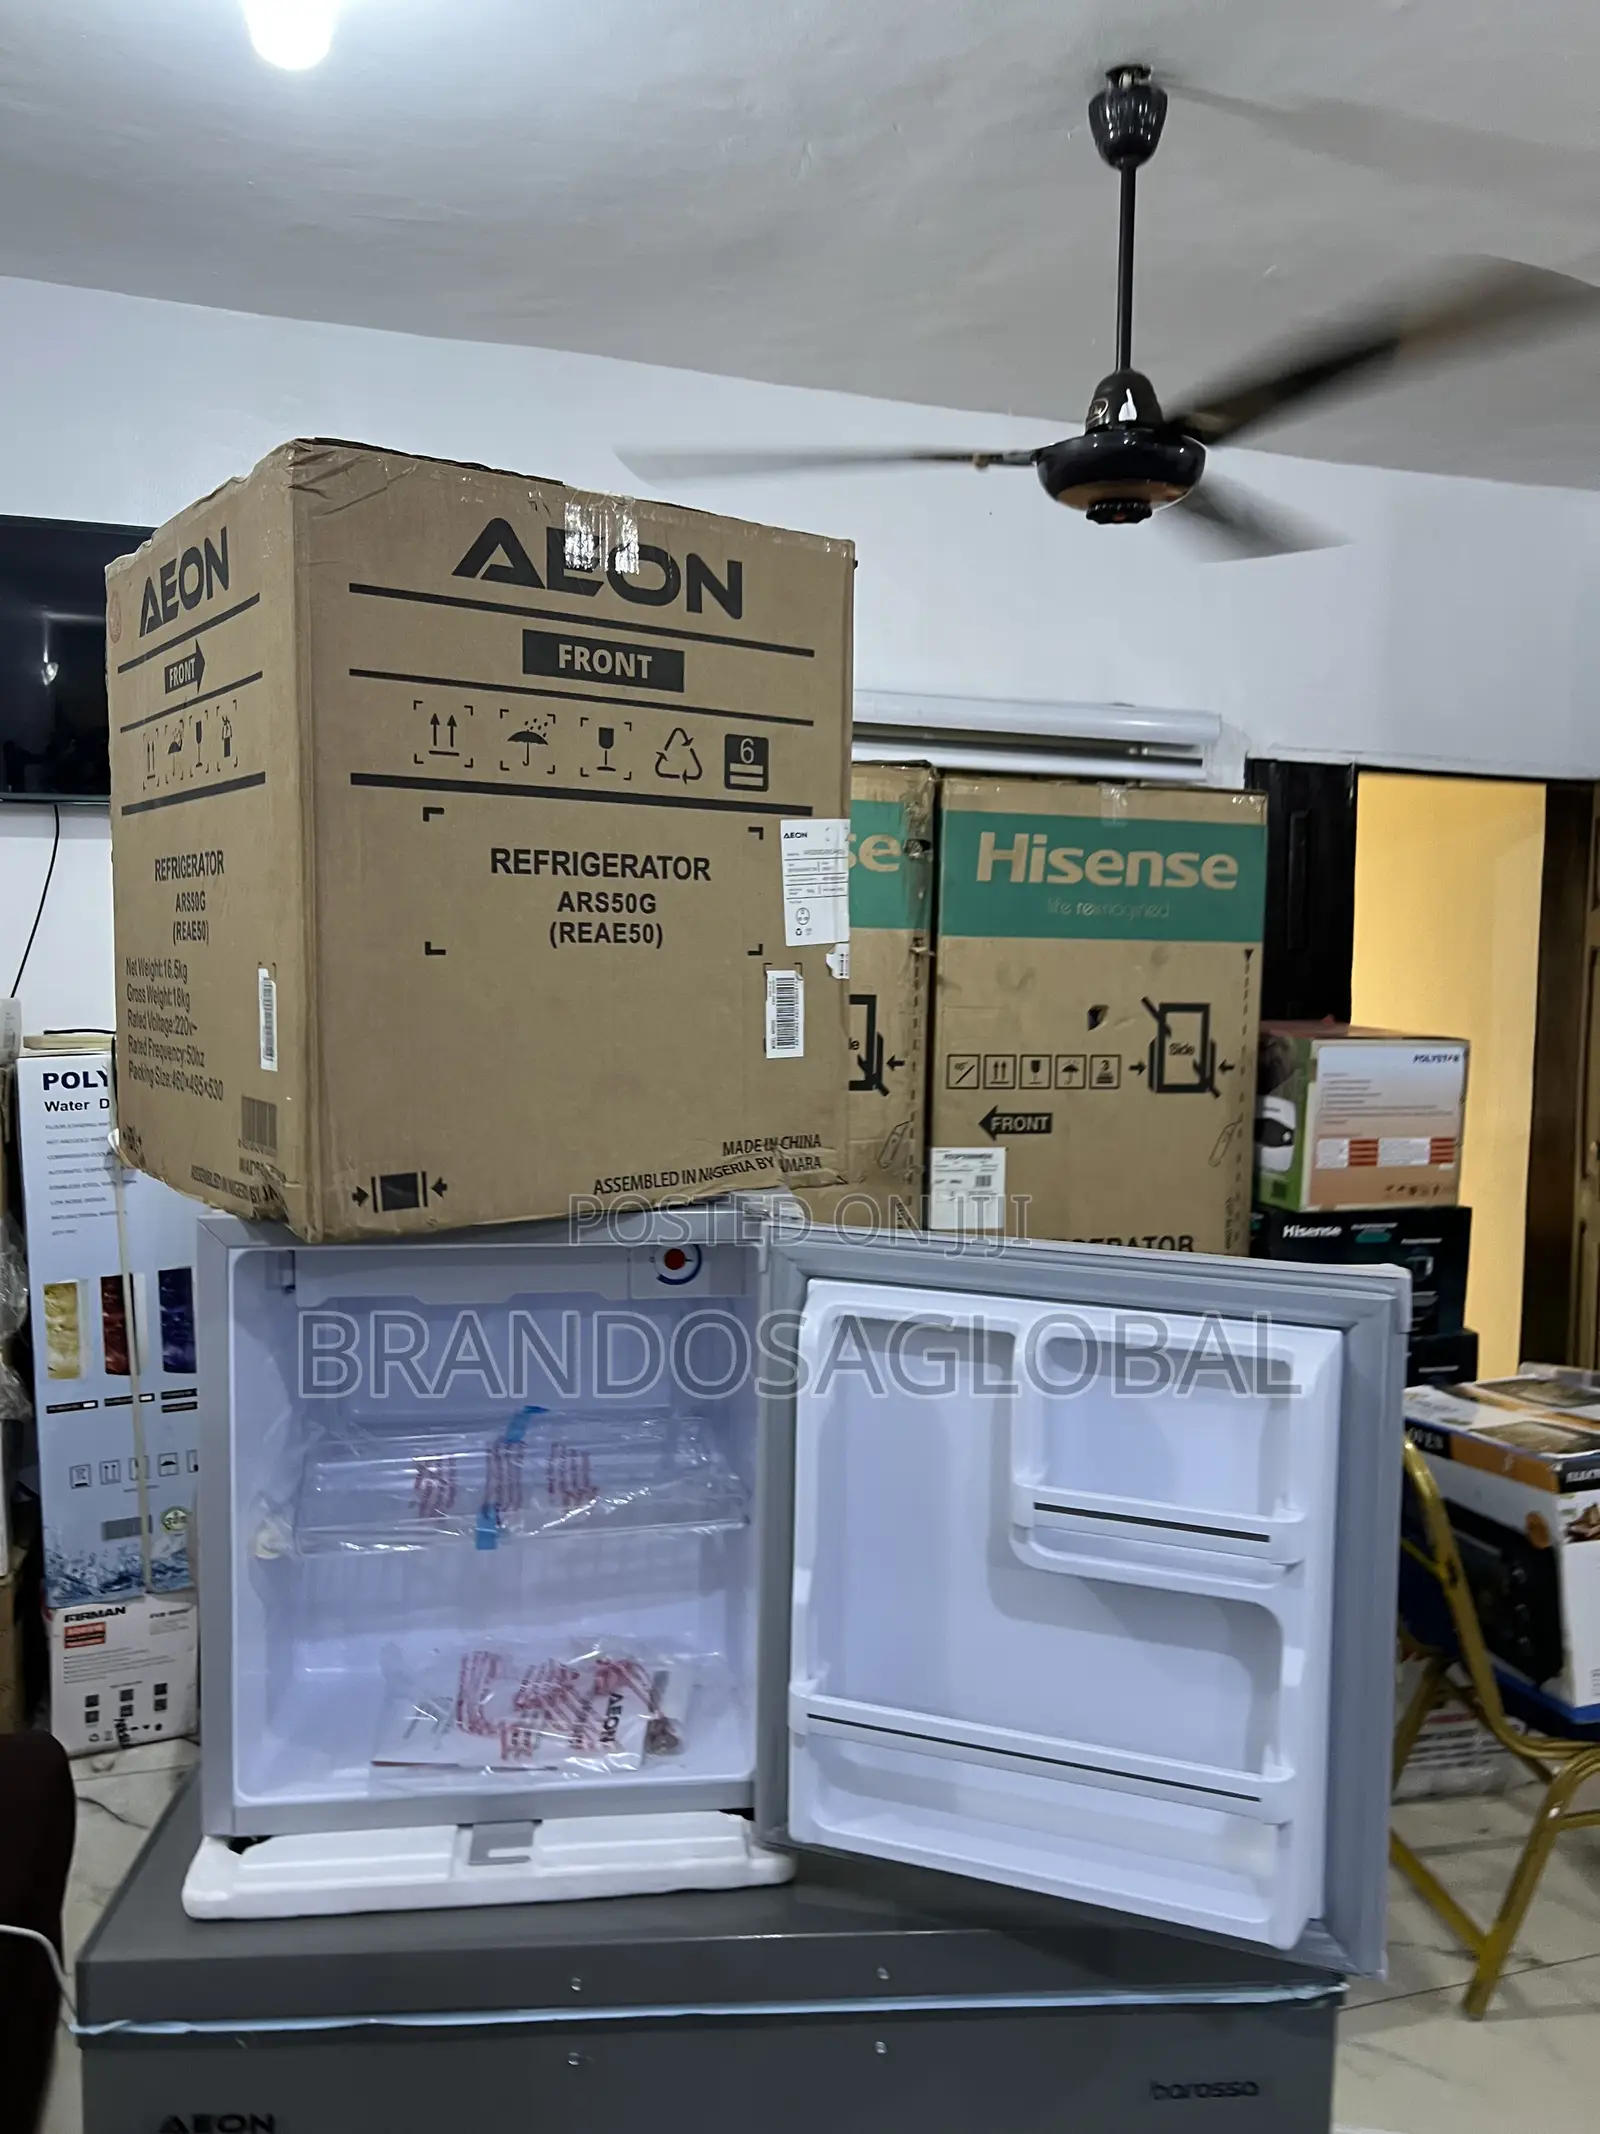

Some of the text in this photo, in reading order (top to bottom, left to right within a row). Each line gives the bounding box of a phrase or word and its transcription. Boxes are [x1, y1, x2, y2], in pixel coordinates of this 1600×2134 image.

[451, 518, 743, 620] AEON
[139, 525, 229, 638] AEON
[169, 657, 195, 688] FRONT
[558, 644, 653, 680] FRONT
[739, 738, 755, 764] 6
[783, 831, 808, 839] AEON
[154, 850, 225, 882] REFRIGERATOR
[490, 847, 712, 881] REFRIGERATOR
[976, 831, 1239, 890] Hisense
[175, 891, 206, 913] ARS50G
[557, 891, 656, 914] ARS50G
[172, 921, 210, 945] (REAE50)
[550, 922, 663, 949] (REAE50)
[43, 1070, 108, 1091] POLY
[44, 1101, 90, 1112] Water
[991, 1116, 1049, 1131] FRONT
[722, 1134, 822, 1156] MADE IN CHINA
[593, 1171, 680, 1195] ASSEMBLED
[681, 1168, 696, 1185] IN
[698, 1161, 756, 1183] NIGERIA
[757, 1156, 775, 1171] BY
[1282, 1224, 1342, 1238] Hisense
[64, 1606, 126, 1622] FIRMAN
[159, 2112, 275, 2134] AEON
